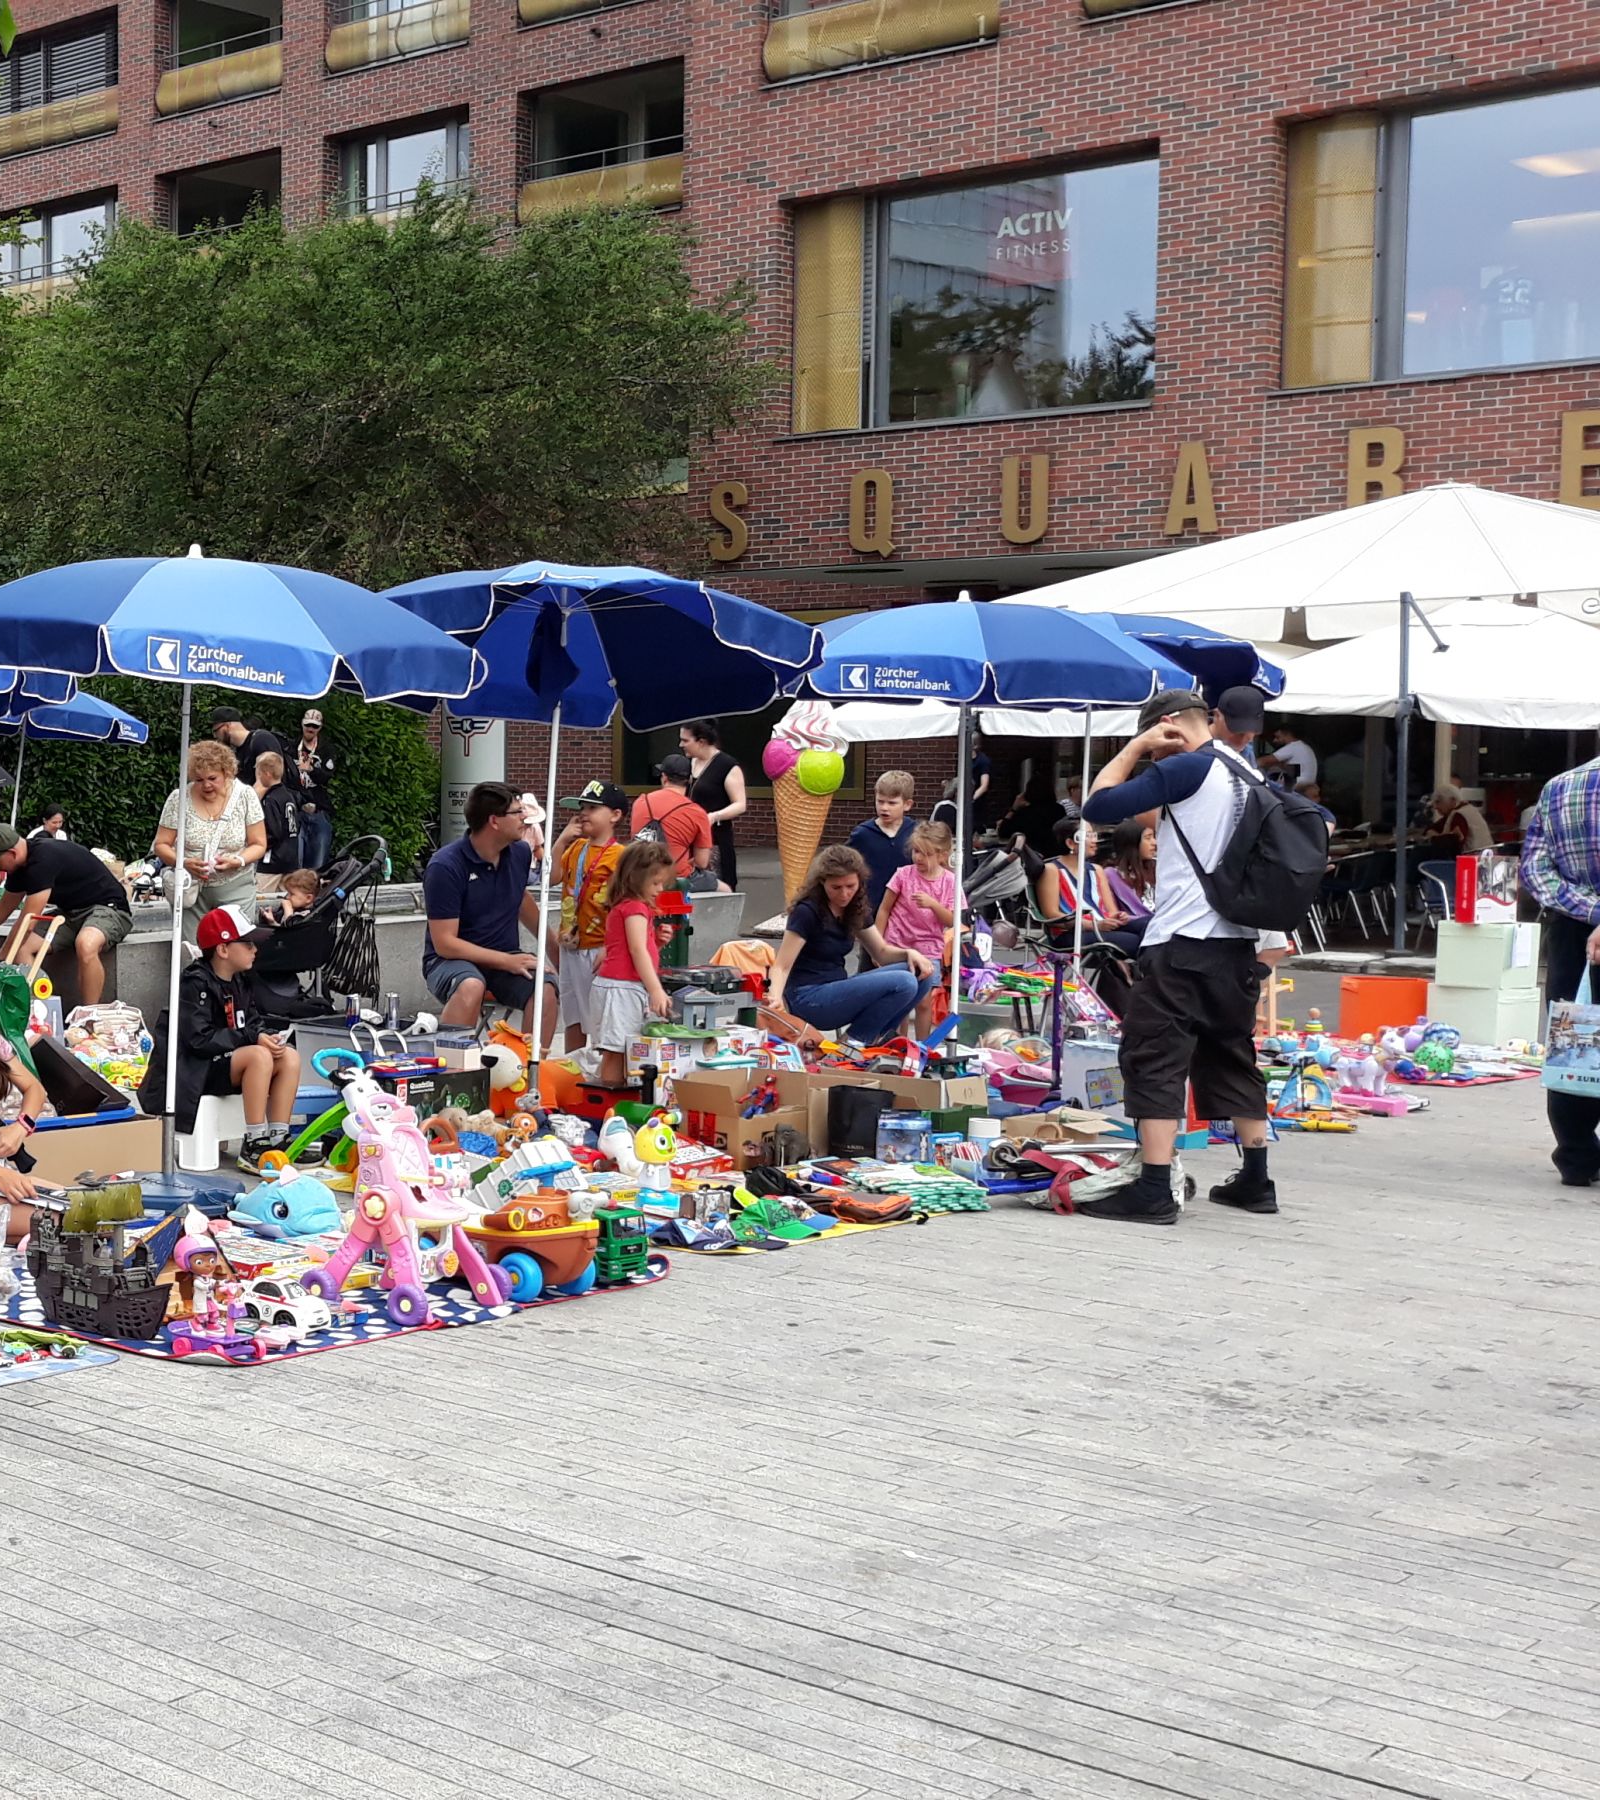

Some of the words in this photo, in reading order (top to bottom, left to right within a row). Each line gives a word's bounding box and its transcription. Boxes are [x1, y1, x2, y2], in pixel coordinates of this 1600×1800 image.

[996, 207, 1074, 239] ACTIV
[995, 239, 1072, 260] FITNESS
[187, 644, 244, 665] Zürcher
[187, 658, 287, 686] Kantonalbank
[874, 666, 920, 679] Zürcher
[873, 678, 952, 692] Kantonalbank
